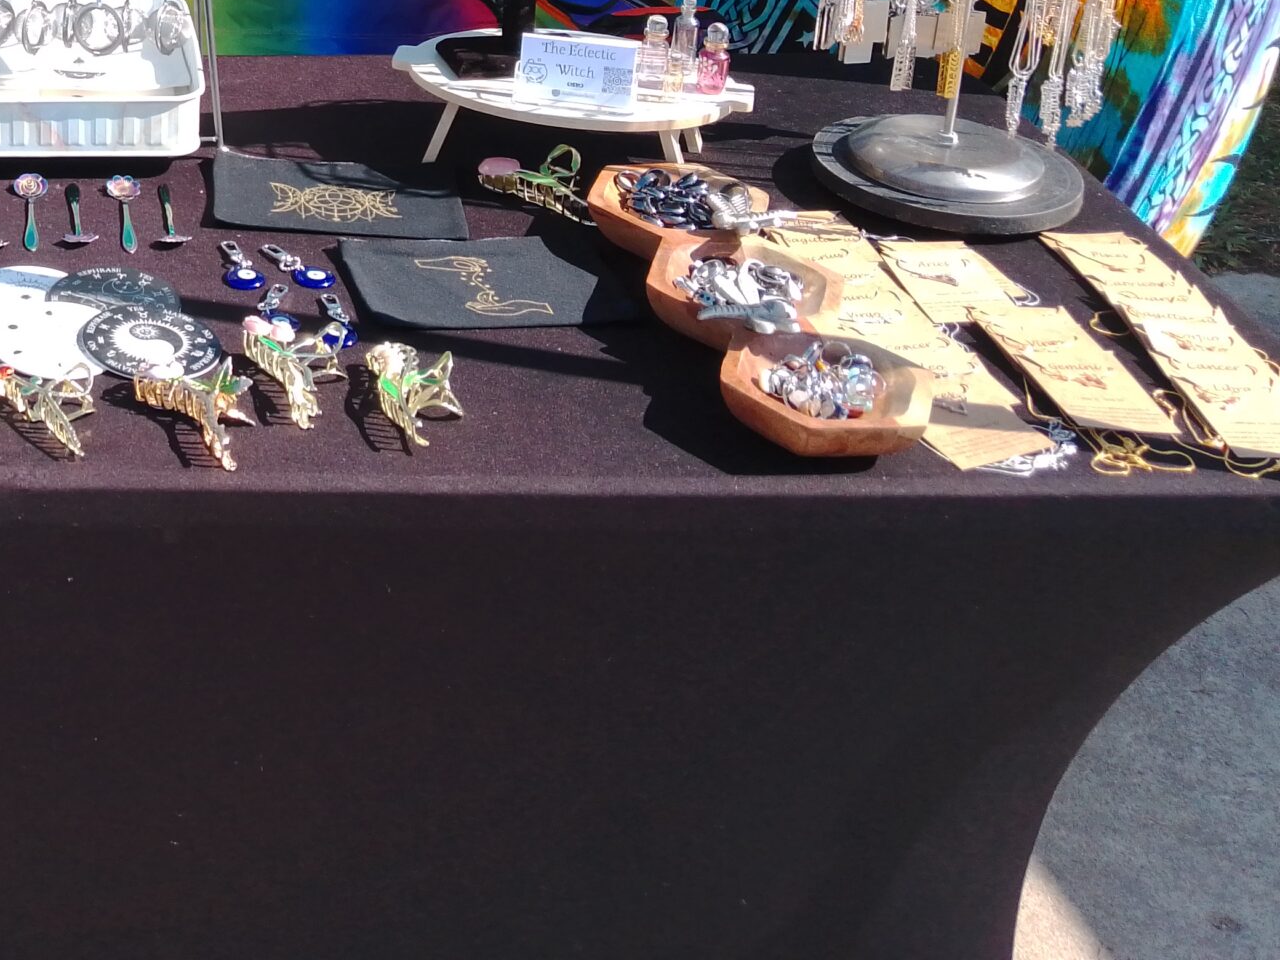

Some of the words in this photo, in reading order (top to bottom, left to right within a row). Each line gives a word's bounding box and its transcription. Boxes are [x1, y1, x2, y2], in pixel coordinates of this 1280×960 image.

[541, 41, 566, 56] The
[568, 43, 617, 61] Eclectic
[555, 63, 595, 79] Witch
